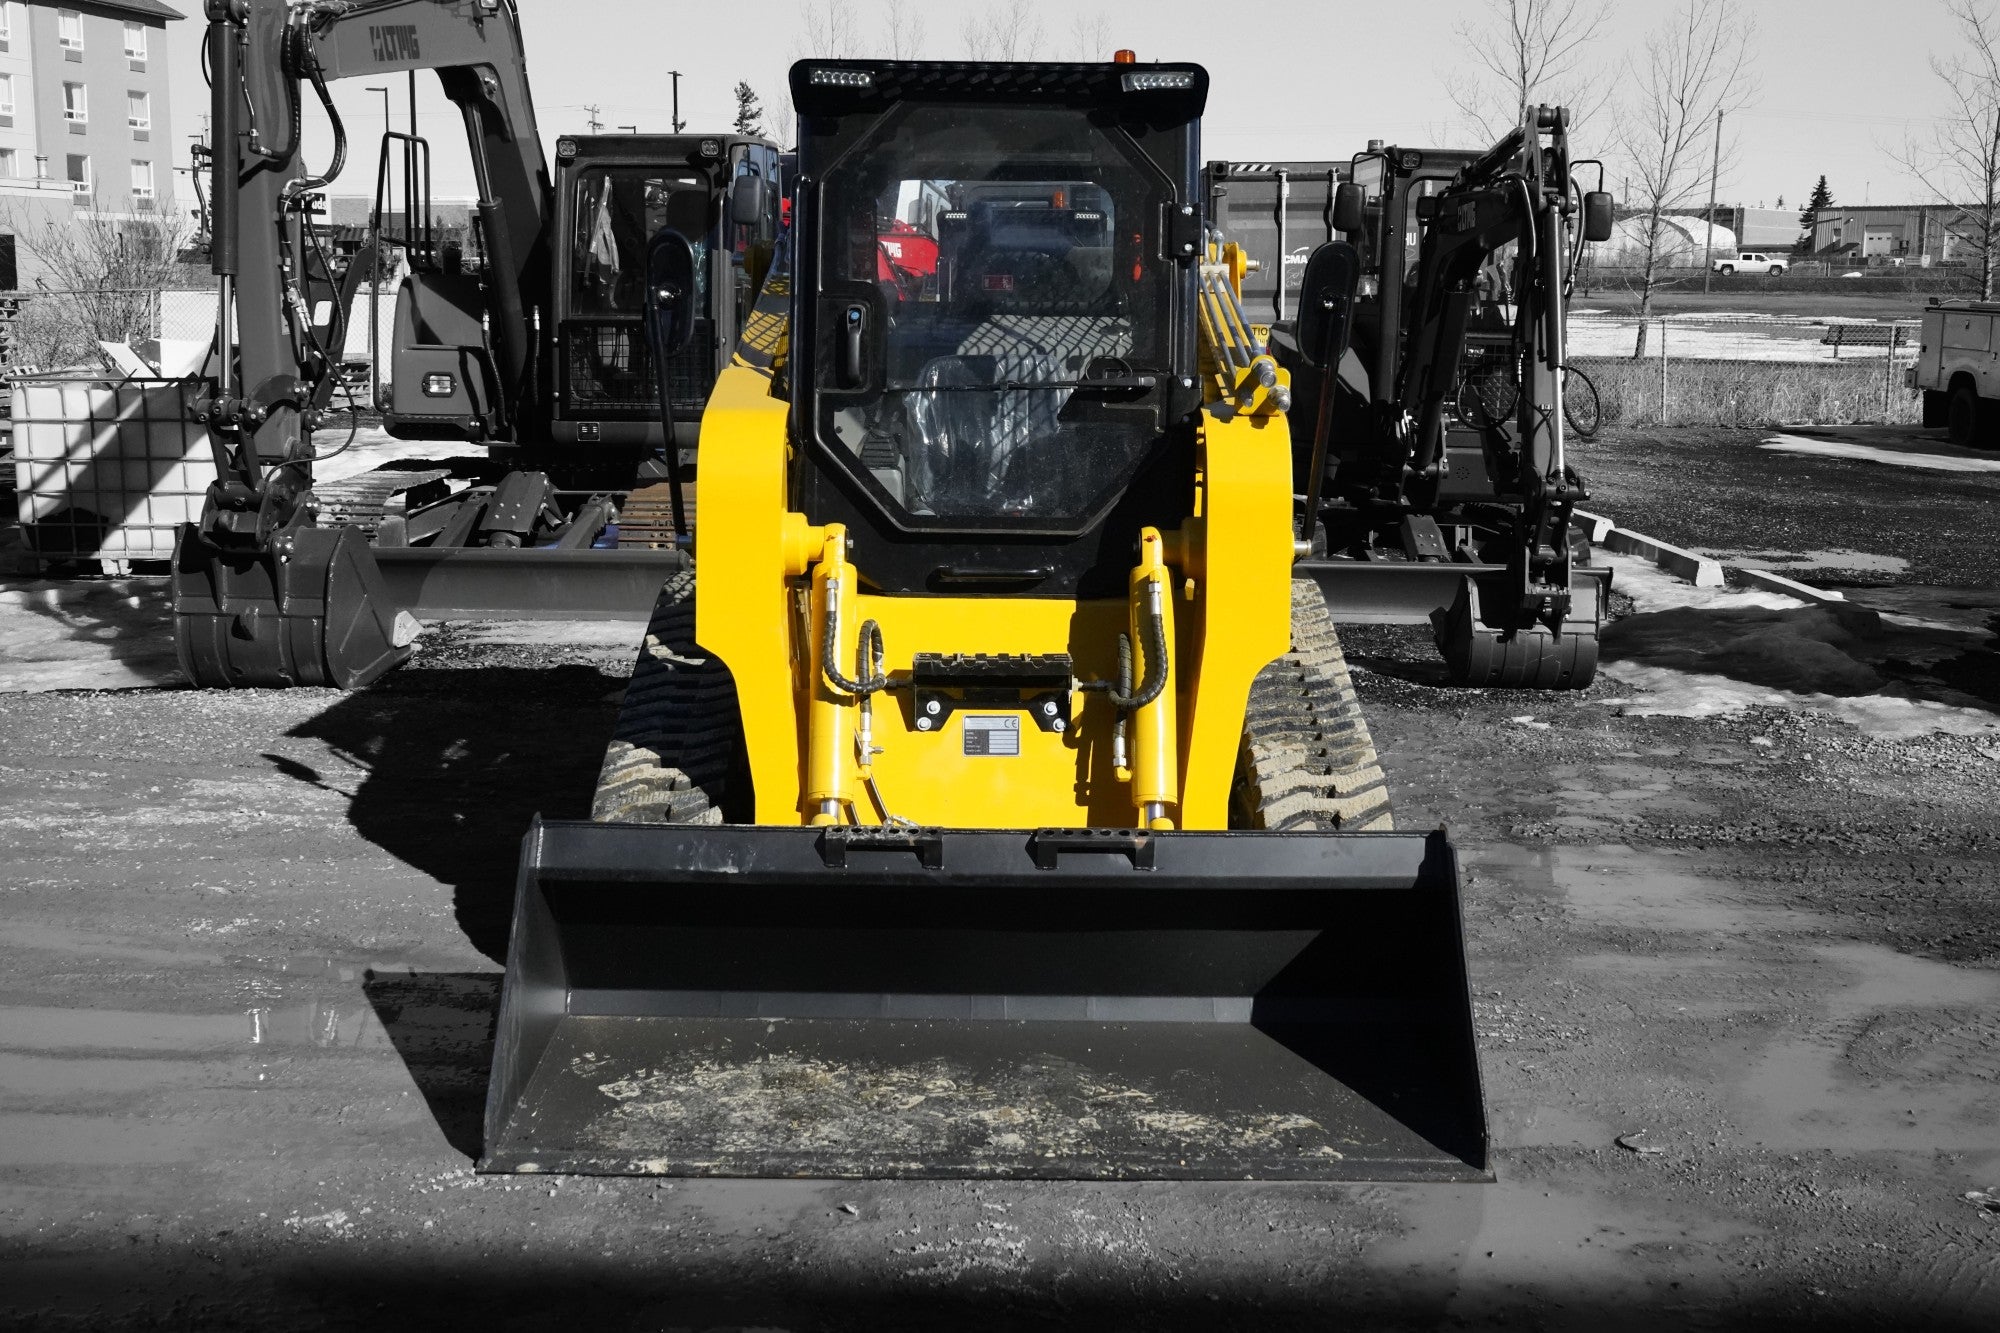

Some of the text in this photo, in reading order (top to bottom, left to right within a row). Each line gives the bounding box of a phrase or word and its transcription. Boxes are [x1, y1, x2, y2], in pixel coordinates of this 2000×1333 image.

[311, 197, 327, 210] uds
[1284, 254, 1308, 264] CMA
[1252, 327, 1268, 336] TIO
